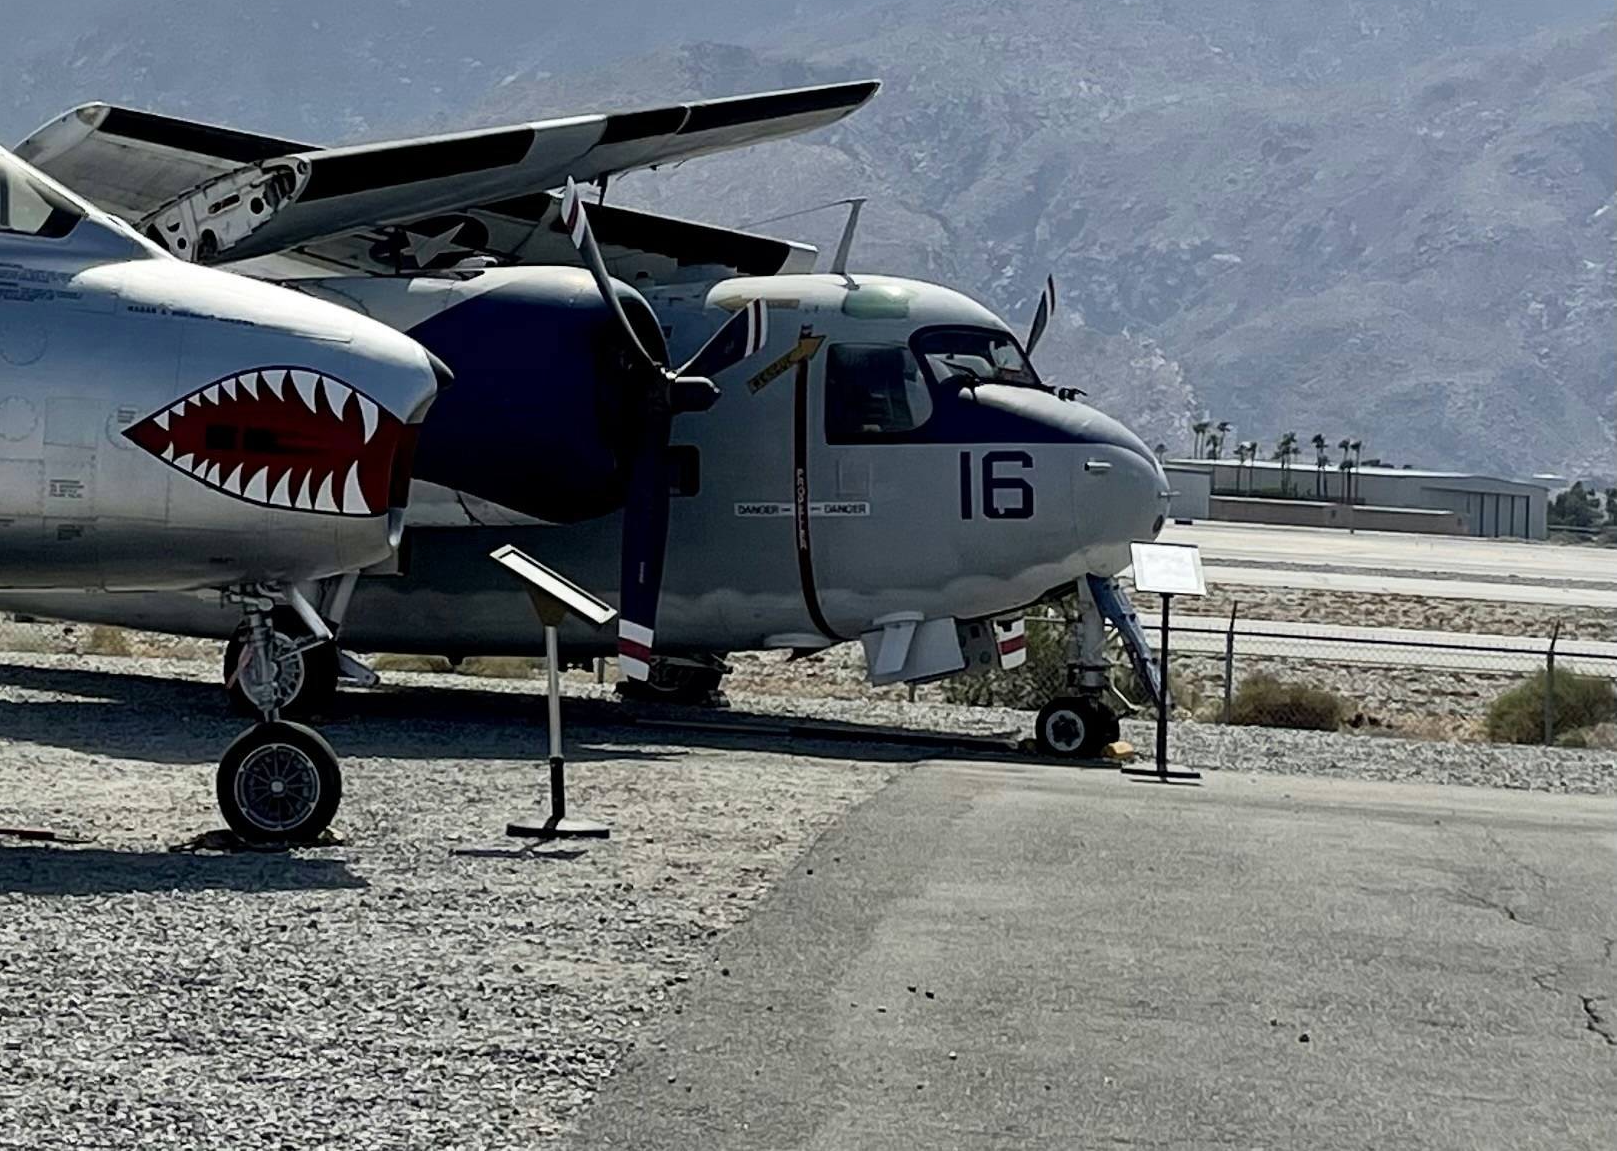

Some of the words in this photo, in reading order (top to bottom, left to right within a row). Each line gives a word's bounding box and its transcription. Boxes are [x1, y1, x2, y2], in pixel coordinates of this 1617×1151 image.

[960, 451, 1034, 520] 16
[738, 504, 779, 515] DANGER
[824, 503, 867, 514] DANGER
